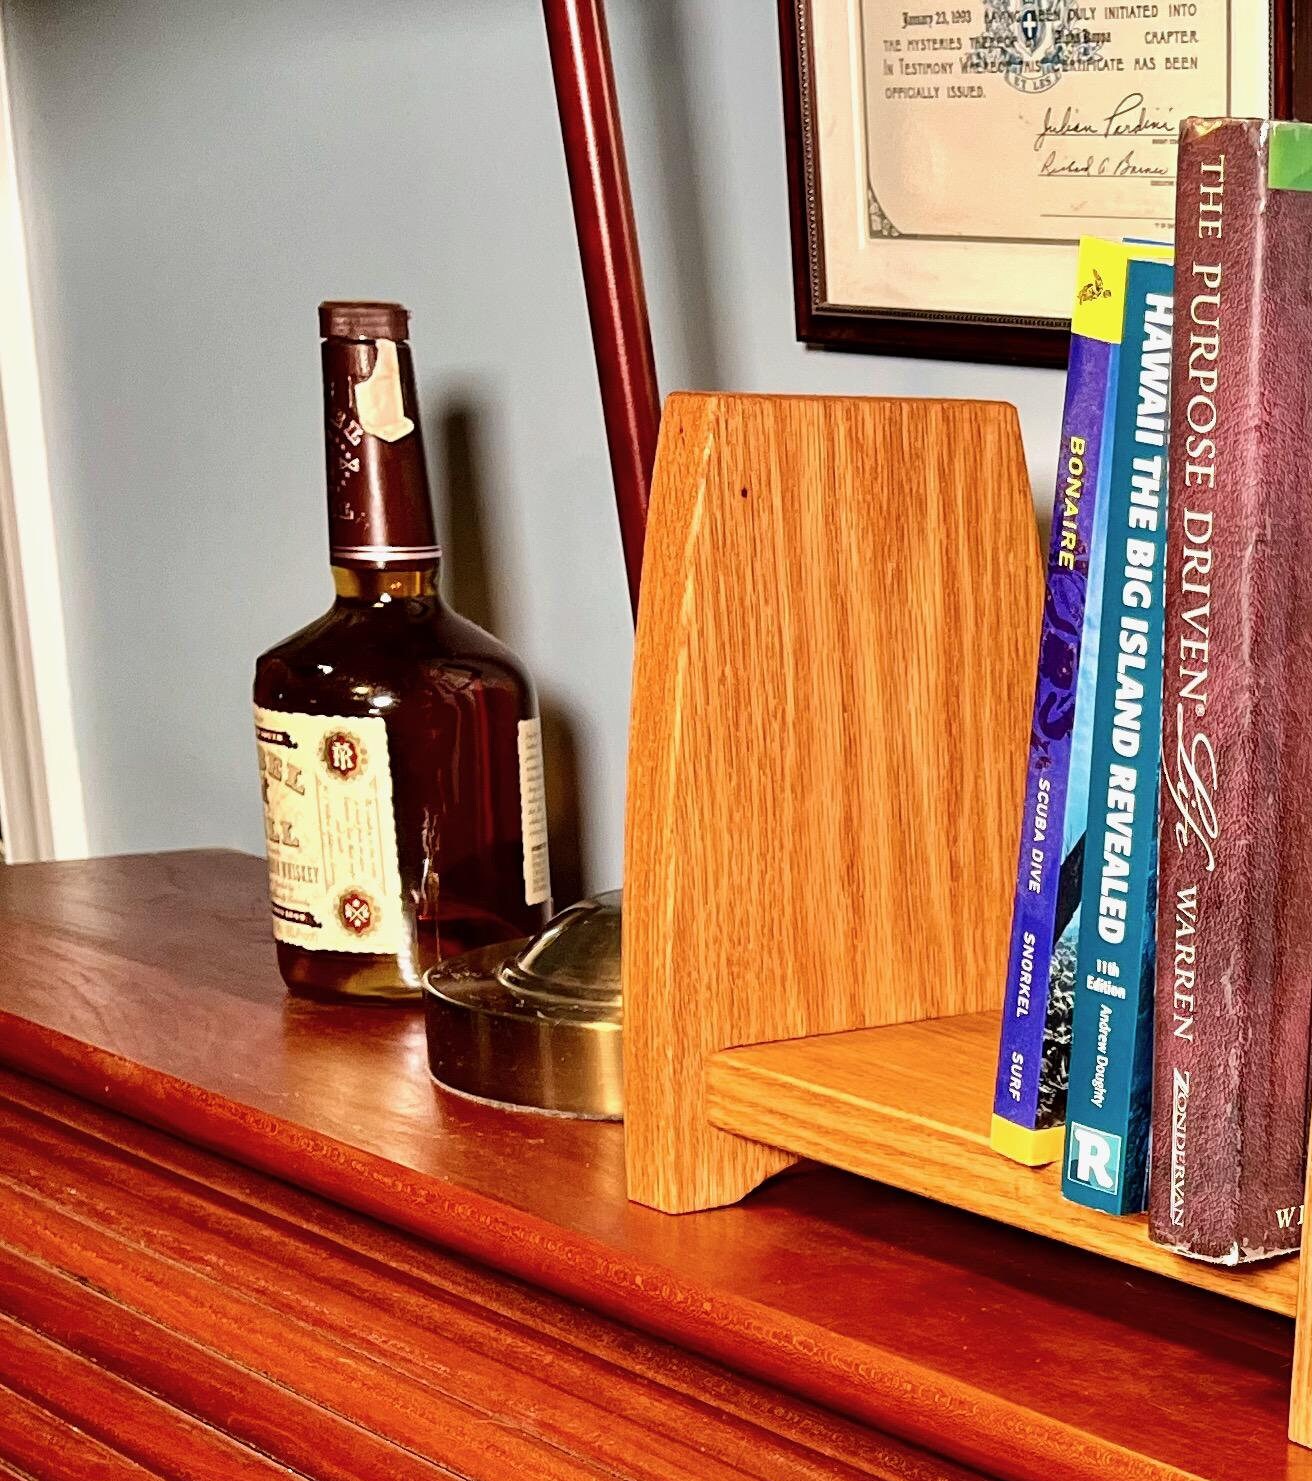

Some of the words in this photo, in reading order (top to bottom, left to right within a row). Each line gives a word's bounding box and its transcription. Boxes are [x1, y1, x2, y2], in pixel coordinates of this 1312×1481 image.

[883, 38, 902, 53] THE
[906, 37, 962, 51] MYSTERIES
[950, 9, 973, 24] 1993
[1067, 7, 1098, 22] DULY
[1104, 5, 1160, 19] INITIATED
[1168, 3, 1198, 17] INTO
[1143, 31, 1200, 45] CHAPTER
[884, 86, 940, 101] OFFICIALLY
[1133, 57, 1157, 71] HAS
[1164, 56, 1200, 71] BEEN
[1196, 154, 1227, 240] THE
[1134, 291, 1175, 447] HAWAII
[1183, 261, 1223, 490] PURPOSE
[1058, 436, 1087, 572] BONAIRE
[1127, 454, 1163, 532] THE
[1122, 538, 1156, 610] BIG
[1110, 618, 1150, 759] ISLAND
[1032, 776, 1052, 843] SCUBA
[1028, 847, 1044, 895] DIVE
[1096, 765, 1138, 946] REVEALED
[1014, 931, 1037, 1019] SNORKEL
[1086, 974, 1127, 1000] Edition
[1095, 958, 1121, 978] 11th
[1173, 884, 1199, 1043] WARREN
[1096, 1003, 1113, 1055] Andrew
[1007, 1049, 1025, 1103] SURF
[1090, 1055, 1109, 1109] Doughty
[1169, 1067, 1193, 1228] ZONDERVAN
